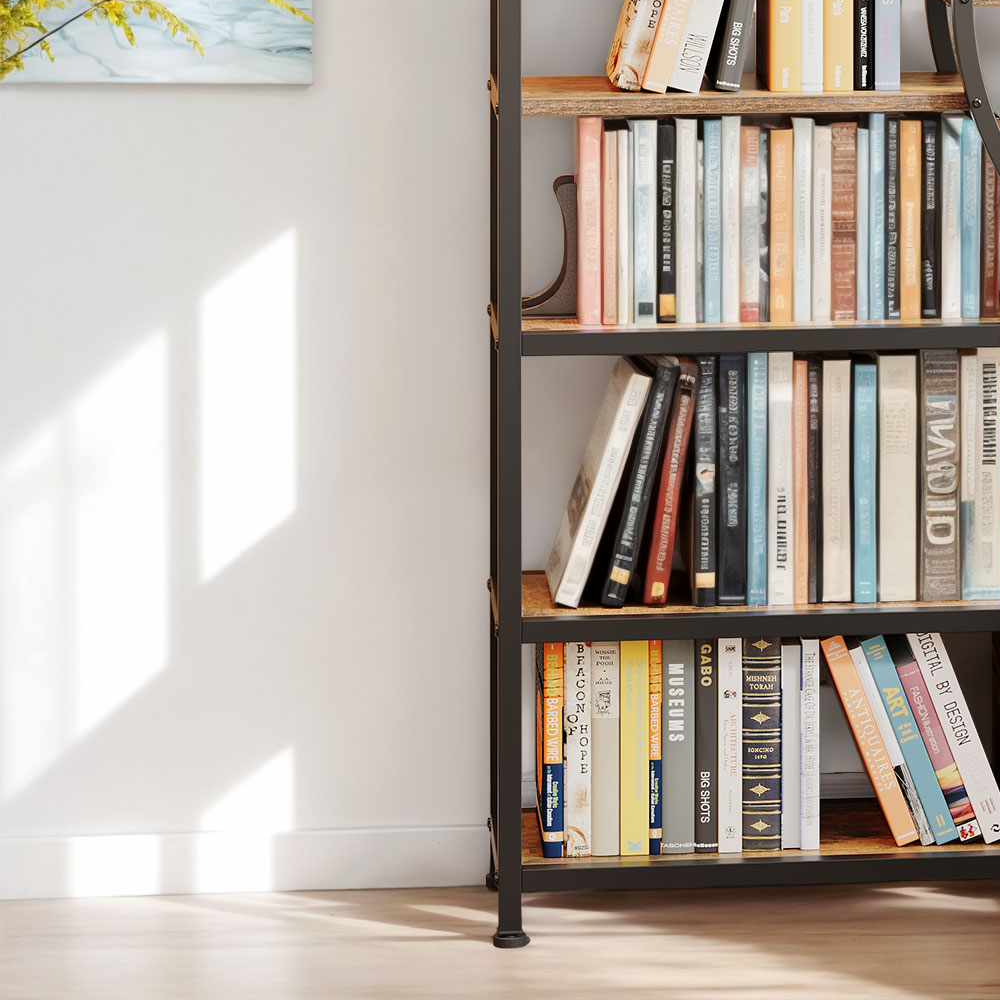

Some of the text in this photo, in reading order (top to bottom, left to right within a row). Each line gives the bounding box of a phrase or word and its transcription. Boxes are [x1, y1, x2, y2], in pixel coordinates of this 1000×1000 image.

[779, 6, 792, 23] Paris
[679, 33, 708, 74] WILLSON
[726, 21, 743, 66] BIG SHOTS
[700, 643, 713, 687] GABO
[935, 680, 953, 695] BY
[546, 654, 559, 762] BEHIND BARBED WIRE
[567, 644, 589, 774] BEACON OF HOPE
[650, 649, 659, 758] BEHIND BARBED WIRE
[668, 663, 684, 741] MUSEUMS
[882, 687, 909, 718] ART
[943, 701, 971, 746] DESIGN
[848, 689, 897, 791] ANTIQUAIRES
[700, 771, 710, 823] BIG SHOTS
